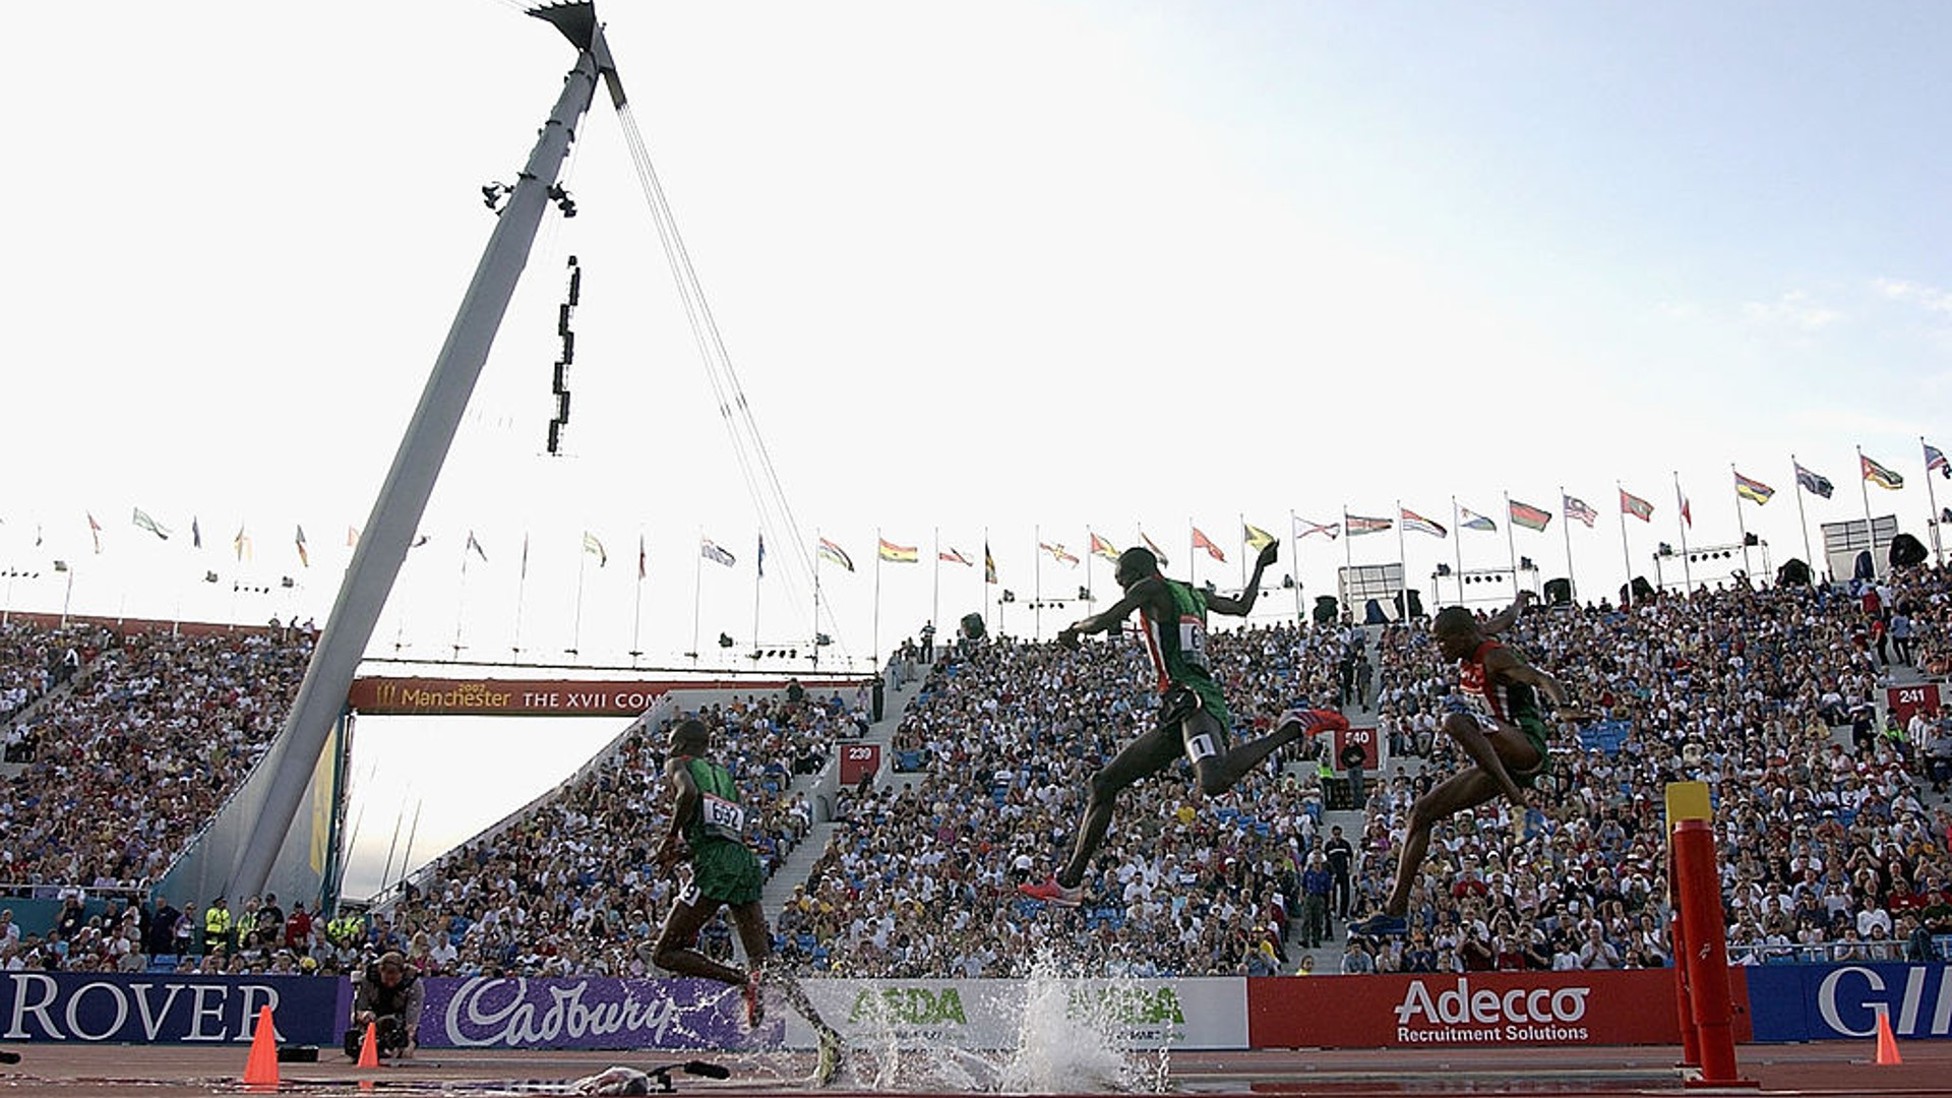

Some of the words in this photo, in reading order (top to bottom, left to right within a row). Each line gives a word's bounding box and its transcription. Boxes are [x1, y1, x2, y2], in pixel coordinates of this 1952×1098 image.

[401, 688, 512, 707] Manchester
[523, 692, 559, 708] THE
[566, 692, 606, 708] XVII
[1900, 688, 1925, 704] 241
[849, 747, 872, 760] 239
[1192, 737, 1206, 755] 1
[3, 973, 287, 1042] ROVER
[1394, 977, 1591, 1024] Adecco
[445, 976, 676, 1047] Cadbury
[1397, 1025, 1501, 1042] Recruitment
[1505, 1024, 1589, 1041] Solutions
